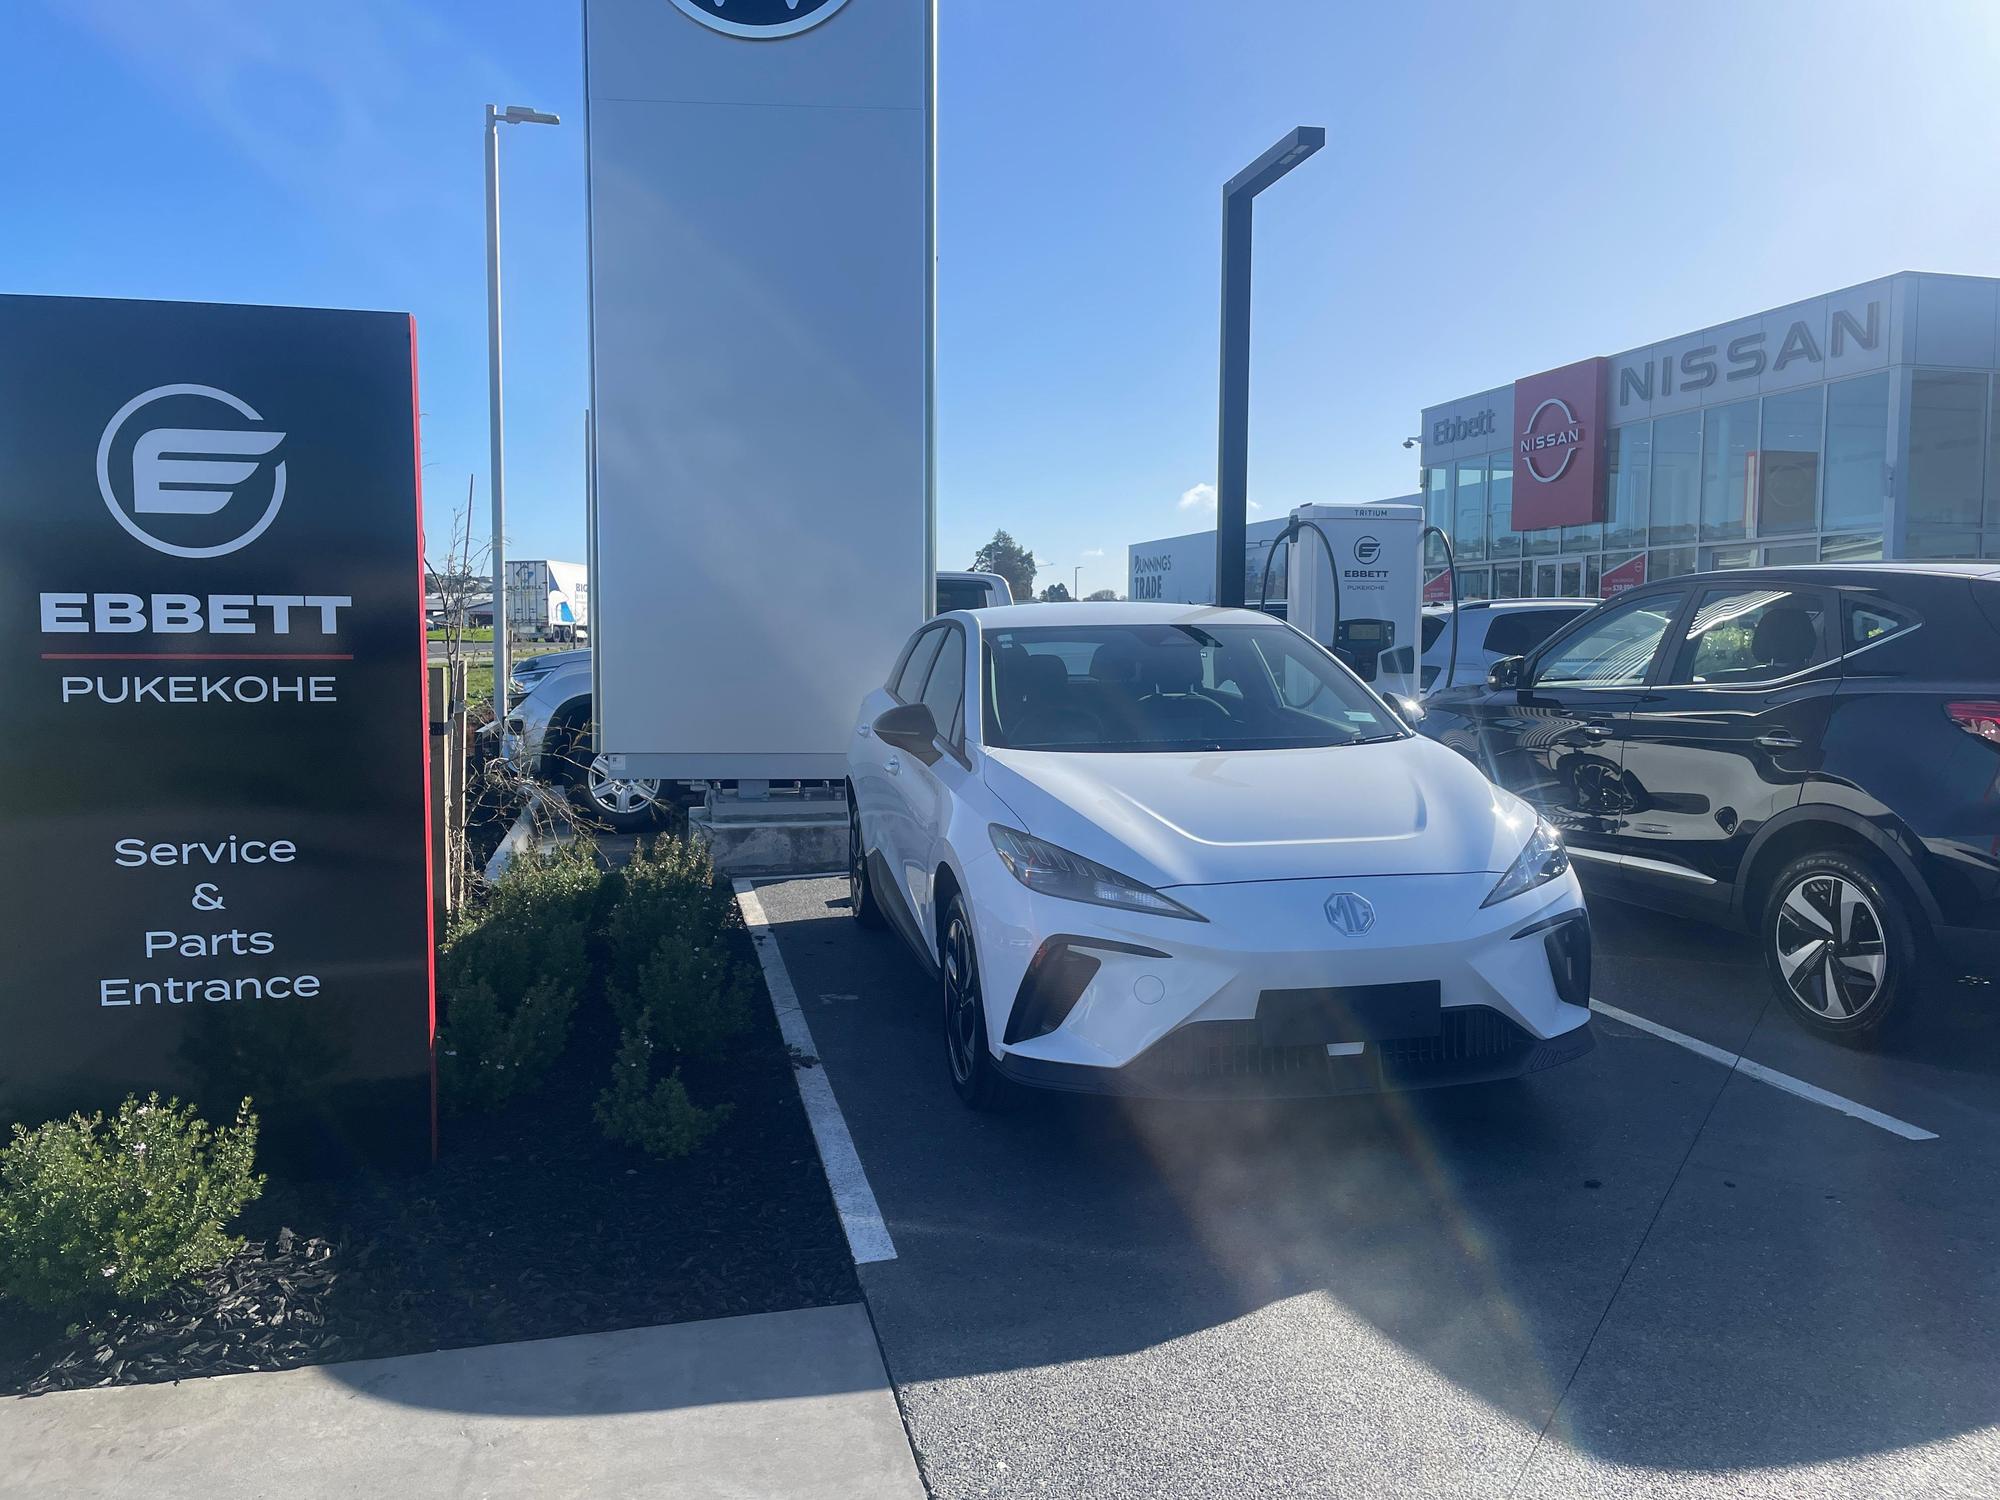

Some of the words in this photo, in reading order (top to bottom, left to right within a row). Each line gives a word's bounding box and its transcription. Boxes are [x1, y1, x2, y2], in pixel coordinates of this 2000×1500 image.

[1619, 301, 1880, 407] NISSAN
[1433, 409, 1496, 446] Ebbett
[1520, 429, 1579, 452] NISSAN
[1354, 509, 1388, 517] TRITIUM
[1134, 555, 1172, 574] BUNNINGS
[1344, 570, 1389, 578] EBBETT
[1134, 575, 1162, 599] TRADE
[40, 592, 353, 634] EBBETT
[62, 676, 337, 703] PUKEKOHE
[114, 834, 297, 867] Service
[191, 882, 226, 911] &
[145, 929, 275, 958] Parts
[100, 975, 321, 1007] Entrance
